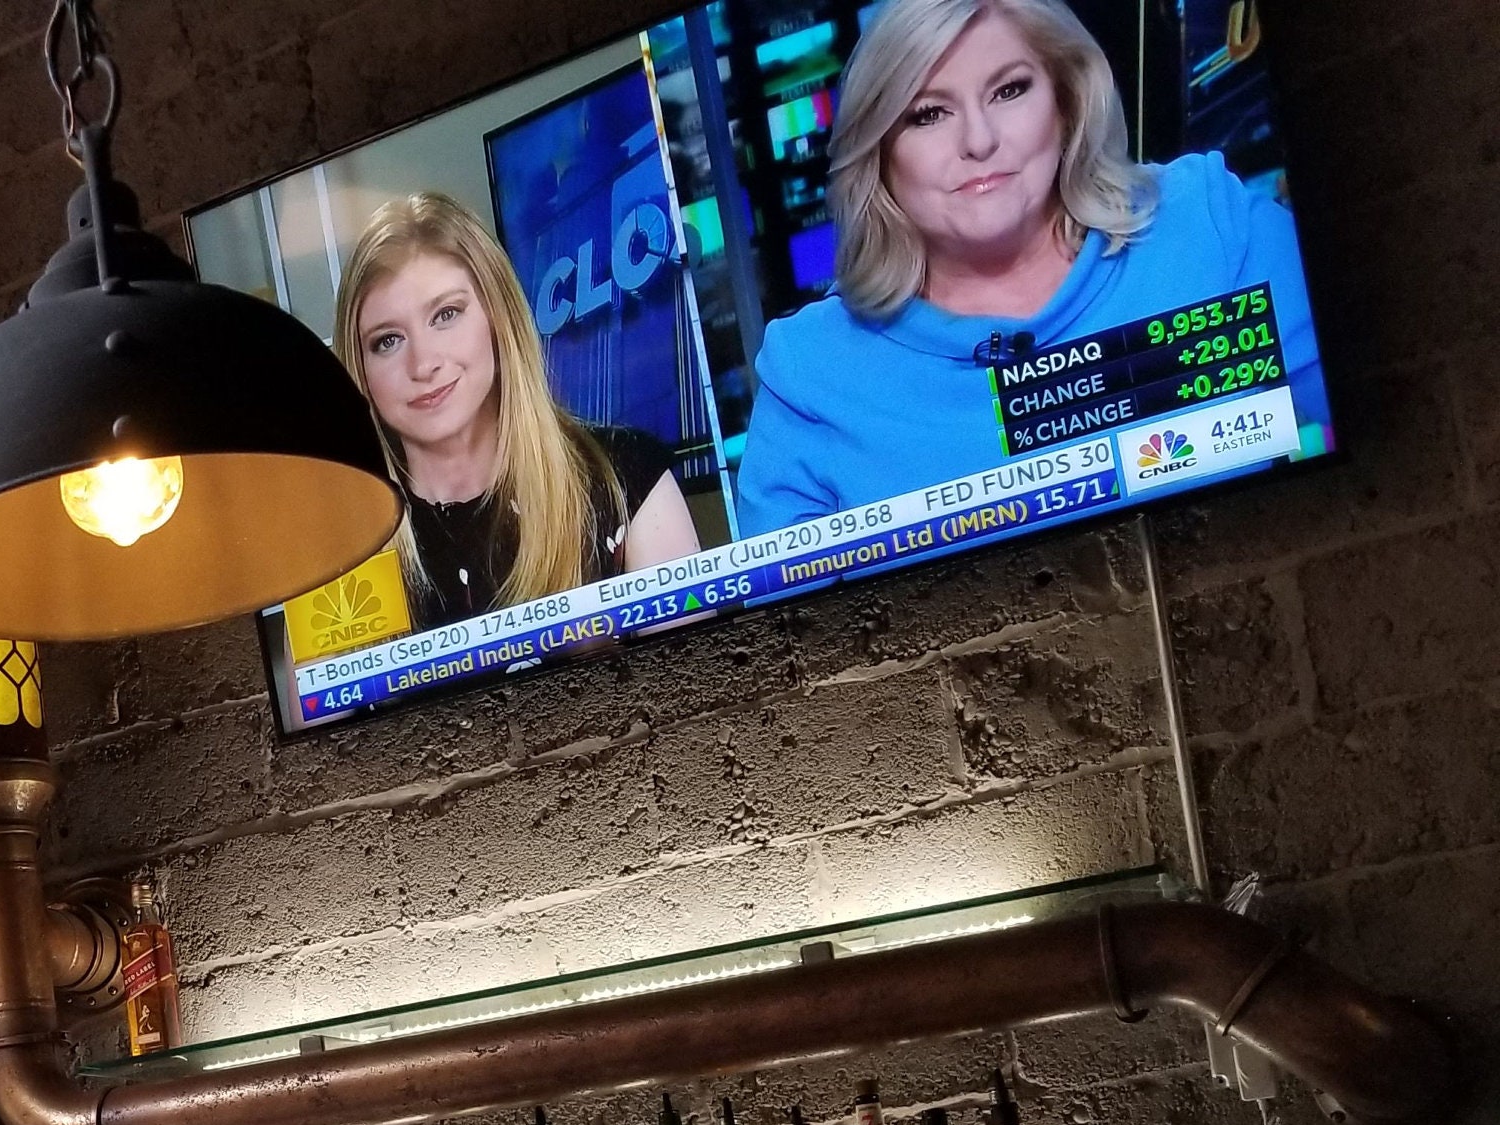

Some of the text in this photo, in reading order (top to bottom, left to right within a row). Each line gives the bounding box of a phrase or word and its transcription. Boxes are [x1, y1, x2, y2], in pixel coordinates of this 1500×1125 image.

[536, 203, 681, 335] CLO
[1003, 289, 1268, 386] NASDAQ 9,953.75
[1009, 323, 1274, 416] CHANGE +29.01
[1014, 355, 1280, 449] % CHANGE +0.29%
[1213, 430, 1273, 454] EASTERN
[1138, 457, 1198, 480] CNBC
[305, 442, 1110, 688] T-Bonds (Sep'20) 174.4688 Euro-Dollar (Jun'20) 99.68 FED FUNDS 30
[324, 485, 1106, 710] 4.64 Lakeland Indus (LAKE) 22.13 6.56 Immuron Ltd (IMRN) 15.71
[312, 615, 389, 649] CNBC
[135, 962, 155, 977] LABEL
